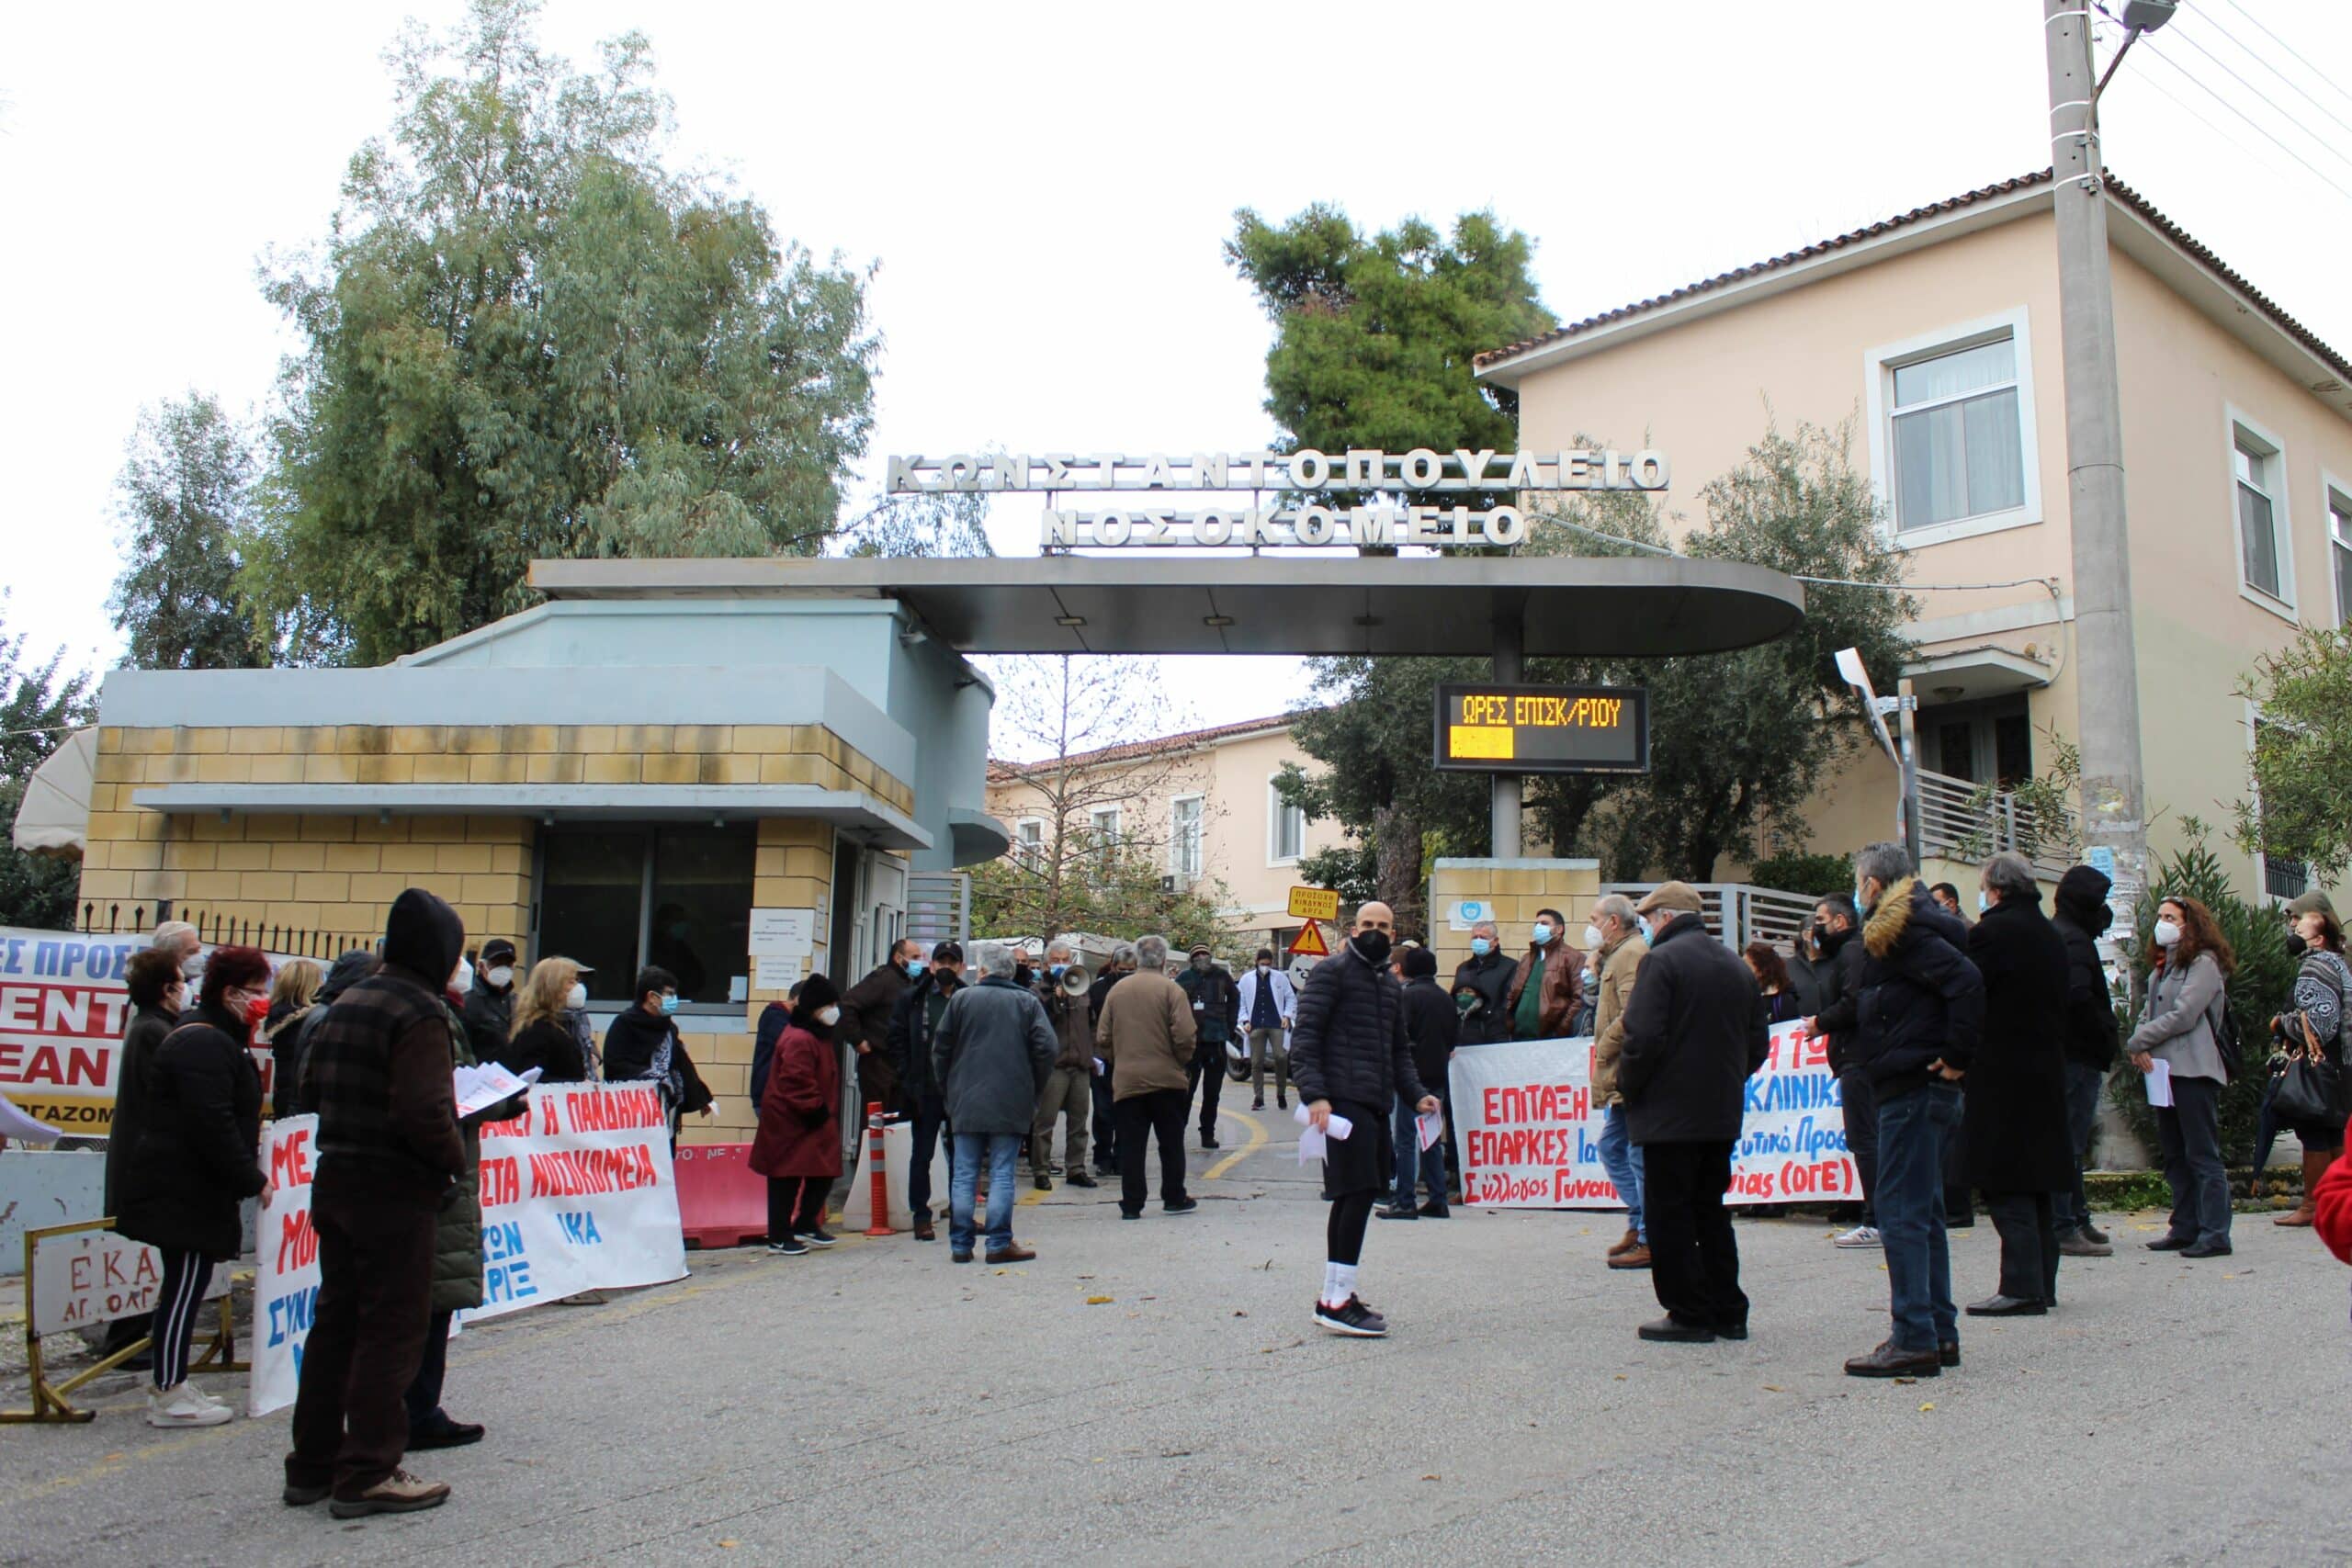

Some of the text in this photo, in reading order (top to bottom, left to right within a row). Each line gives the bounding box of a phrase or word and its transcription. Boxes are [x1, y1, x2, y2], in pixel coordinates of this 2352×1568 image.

[888, 448, 1669, 493] ΚΩΝΣΤΑΝΤΟΠΟΥΛΕΙΟ
[1042, 505, 1525, 547] ΝΟΣΟΚΟΜΕΙΟ
[1463, 695, 1621, 727] ΩΡΕΣ ΕΠΙΣΚ/ΡΙΟΥ
[1294, 898, 1332, 908] ΚΙΝΔΥΝΟΣ
[1295, 890, 1333, 900] ΠΡΟΣΟΧΗ
[34, 940, 151, 981] ΠΡΟΣ
[567, 1088, 664, 1133] ΠΑΝΔΗΜΙΑ
[1484, 1084, 1588, 1125] ΕΠΙΤΑΞΗ
[1467, 1128, 1568, 1168] ΕΠΑΡΚΕΣ
[528, 1144, 657, 1198] ΝΟΣΟΚΟΜΕΙΑ
[1464, 1172, 1548, 1204] Σύλλογος
[1780, 1157, 1853, 1195] (ΟΓΕ)
[557, 1211, 602, 1245] ΙΚΑ
[71, 1247, 160, 1293] ΕΚΑ
[482, 1260, 538, 1305] ΡΙΞ
[106, 1286, 161, 1314] ΟΛΓ
